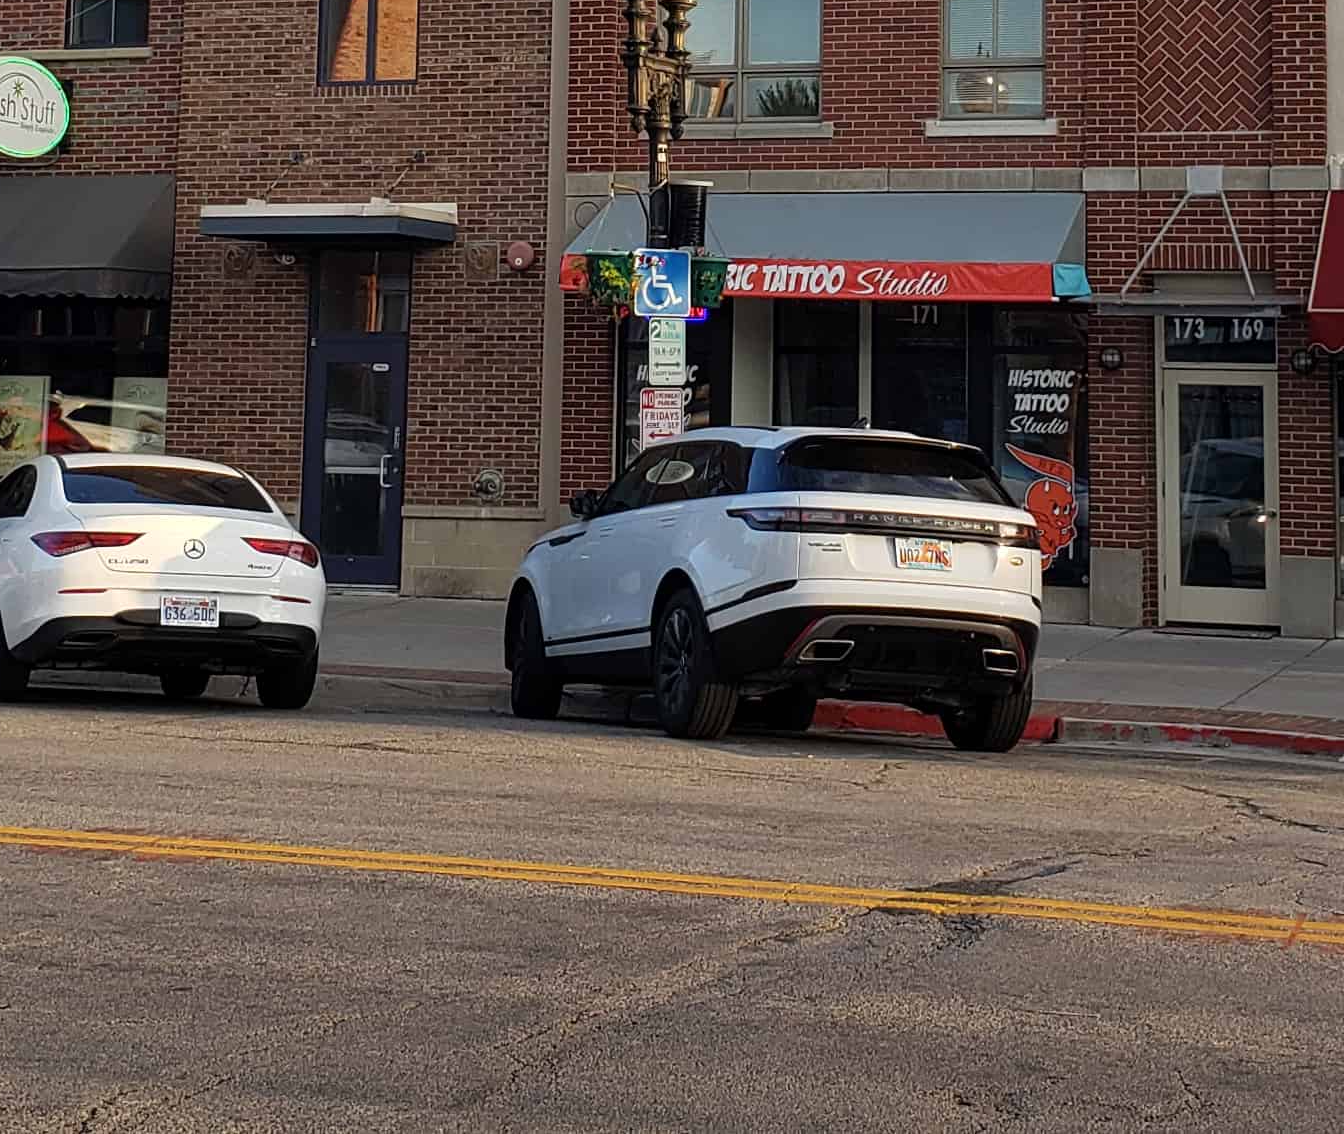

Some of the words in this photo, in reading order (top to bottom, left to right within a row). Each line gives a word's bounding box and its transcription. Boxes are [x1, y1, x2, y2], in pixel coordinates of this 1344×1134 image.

[20, 96, 57, 125] Stuff
[762, 264, 847, 295] TATTOO
[847, 267, 949, 296] Studio
[911, 305, 939, 325] 171
[650, 320, 662, 341] 2
[1173, 317, 1206, 339] 173
[1232, 318, 1264, 340] 169
[1008, 369, 1076, 388] HISTORIC
[1014, 393, 1070, 413] TATTOO
[645, 411, 680, 421] FRIDAYS
[1005, 414, 1069, 435] Studio
